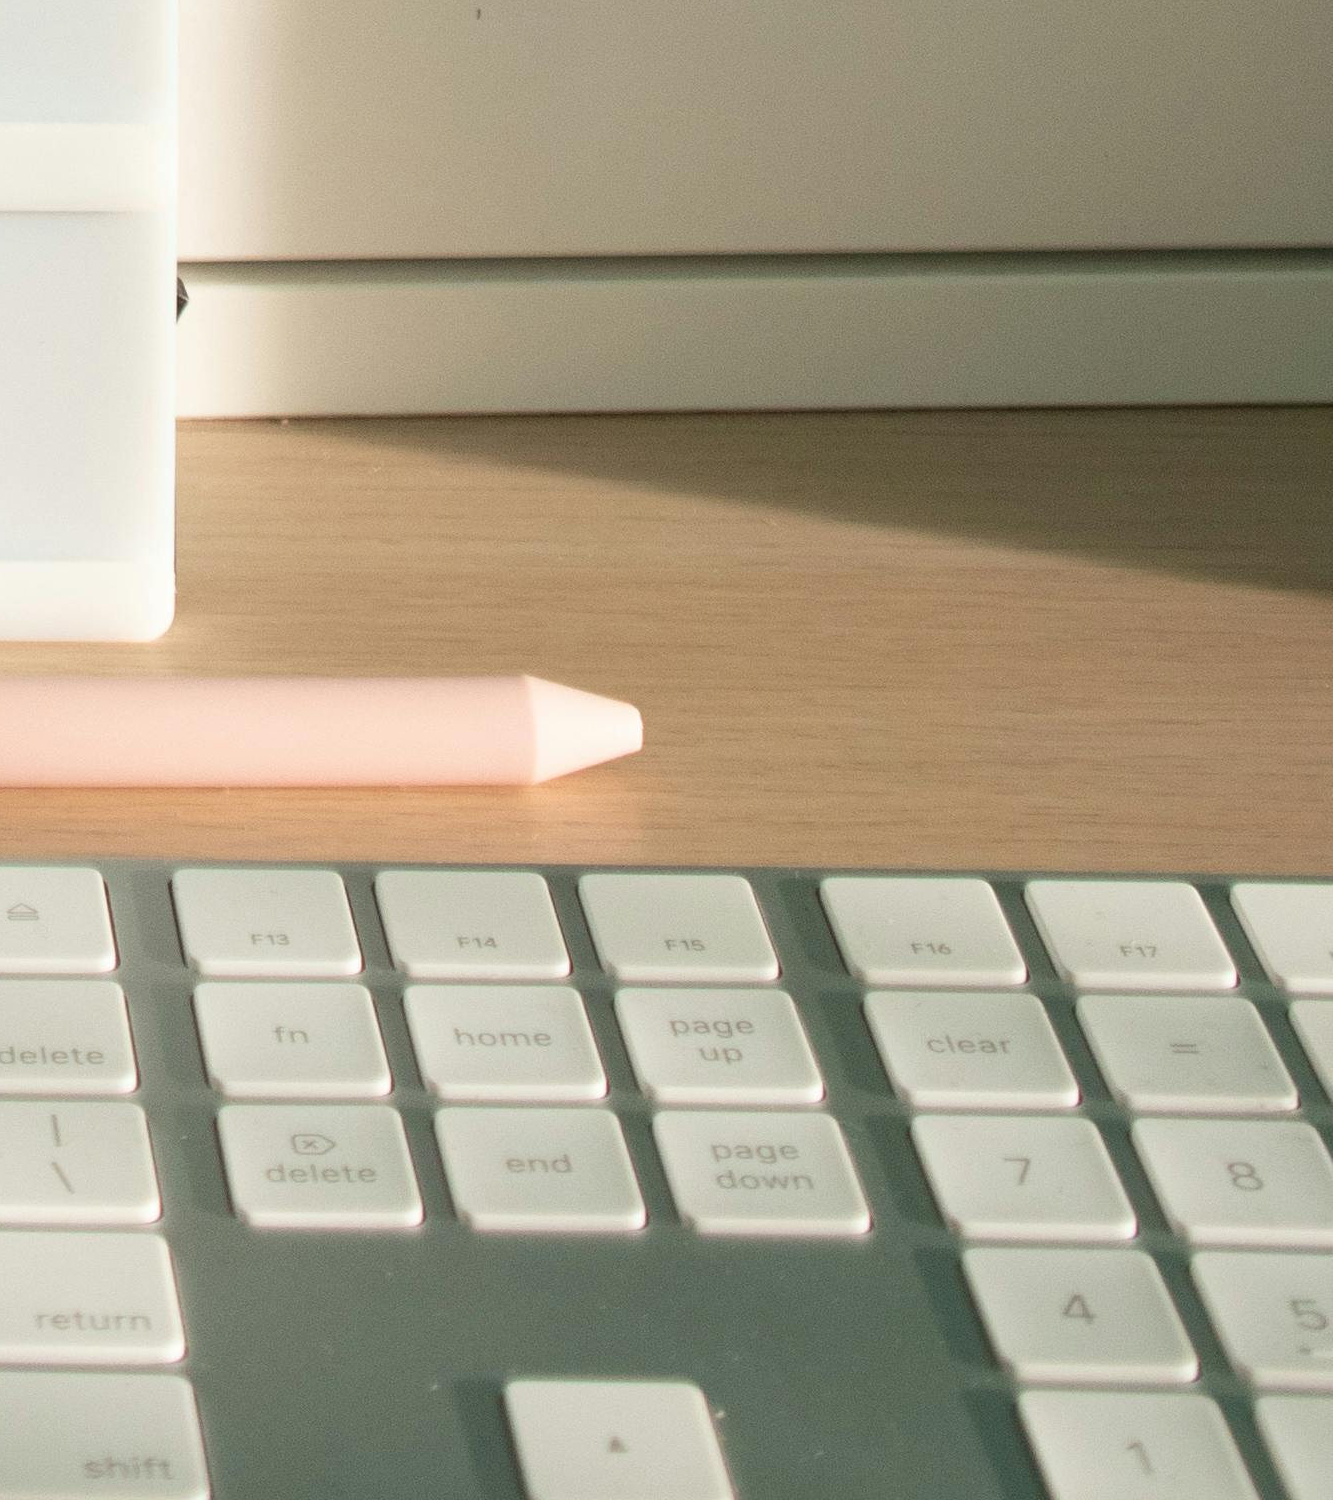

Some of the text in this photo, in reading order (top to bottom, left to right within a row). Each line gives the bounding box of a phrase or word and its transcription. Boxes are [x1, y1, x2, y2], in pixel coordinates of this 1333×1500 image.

[273, 1025, 310, 1044] fn
[453, 1028, 553, 1048] home
[669, 1018, 755, 1039] page
[926, 1034, 1011, 1055] clear
[698, 1046, 744, 1067] up
[505, 1153, 574, 1174] end
[710, 1144, 800, 1165] page
[266, 1161, 378, 1184] delete
[715, 1169, 815, 1191] down
[1004, 1156, 1032, 1186] 7
[1226, 1161, 1265, 1192] 8
[1062, 1293, 1096, 1325] 4
[1289, 1298, 1330, 1333] 5
[34, 1310, 152, 1332] return
[82, 1456, 173, 1480] shift
